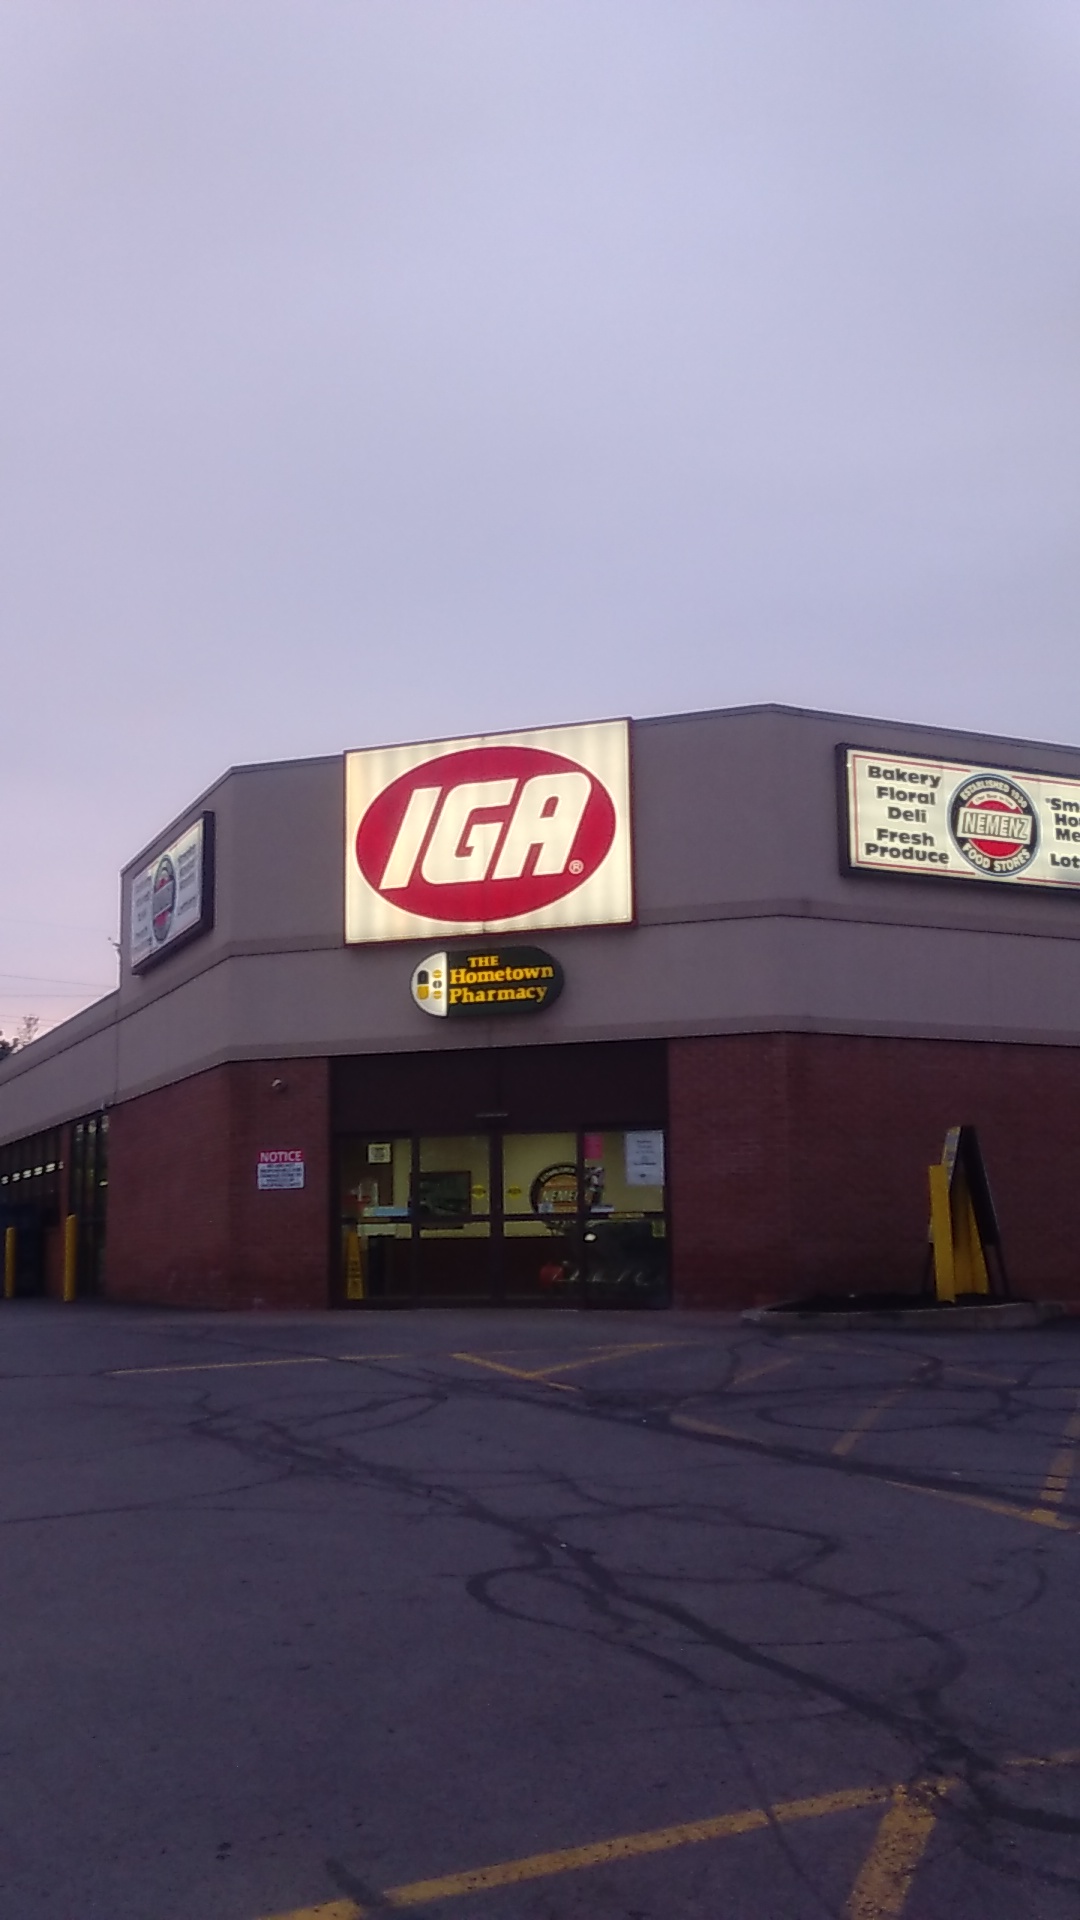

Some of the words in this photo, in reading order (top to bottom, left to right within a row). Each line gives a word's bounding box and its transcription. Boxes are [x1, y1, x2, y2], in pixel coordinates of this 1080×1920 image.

[867, 765, 941, 789] Bakery
[876, 785, 936, 806] Floral
[887, 806, 927, 823] Deli
[1054, 812, 1080, 827] Ho
[379, 771, 592, 890] IGA
[964, 812, 1029, 840] NEMENZ
[1055, 827, 1080, 842] Me
[876, 827, 935, 847] Fresh
[864, 842, 949, 865] Produce
[962, 842, 991, 869] FOOD
[993, 848, 1031, 872] STORES
[1050, 852, 1080, 869] Lot
[467, 955, 499, 968] THE
[449, 965, 554, 985] Hometown
[448, 986, 548, 1004] Pharmacy
[260, 1150, 302, 1162] NOTICE
